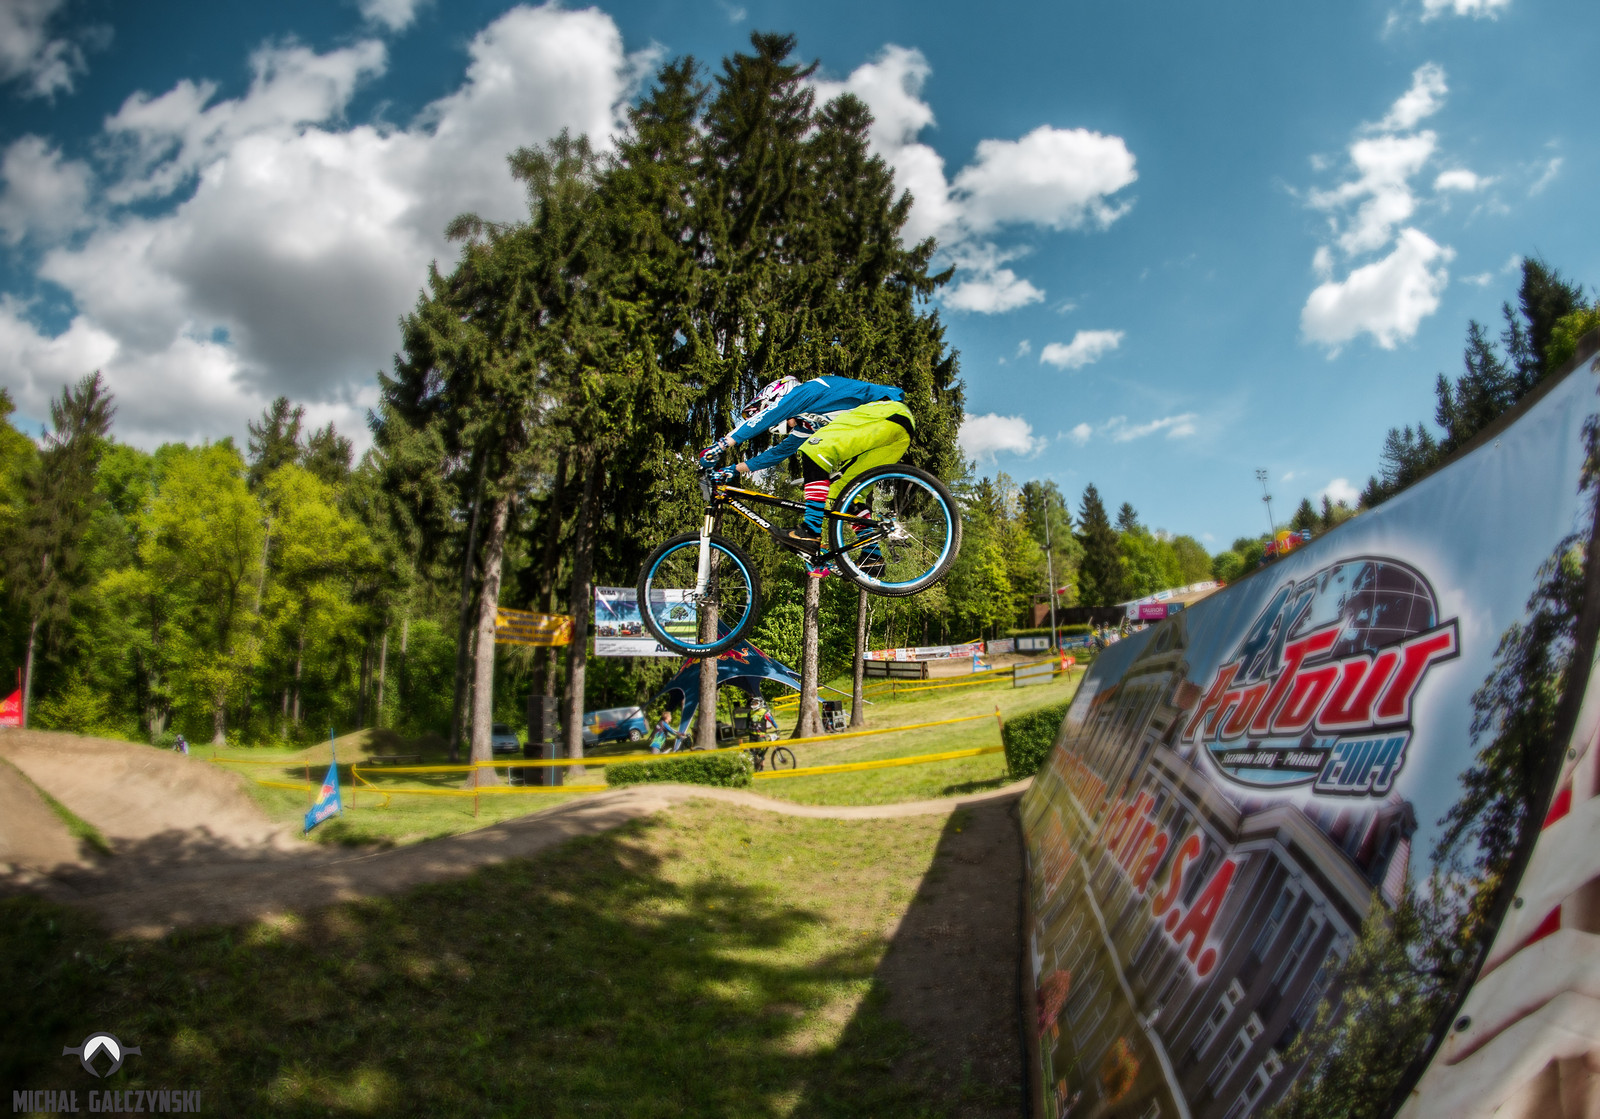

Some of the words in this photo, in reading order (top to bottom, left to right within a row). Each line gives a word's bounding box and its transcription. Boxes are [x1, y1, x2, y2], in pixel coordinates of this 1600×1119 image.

[731, 500, 771, 528] NUKEPRO
[1283, 752, 1325, 767] Poland
[1317, 734, 1408, 788] 2014
[1152, 834, 1218, 977] S.A.
